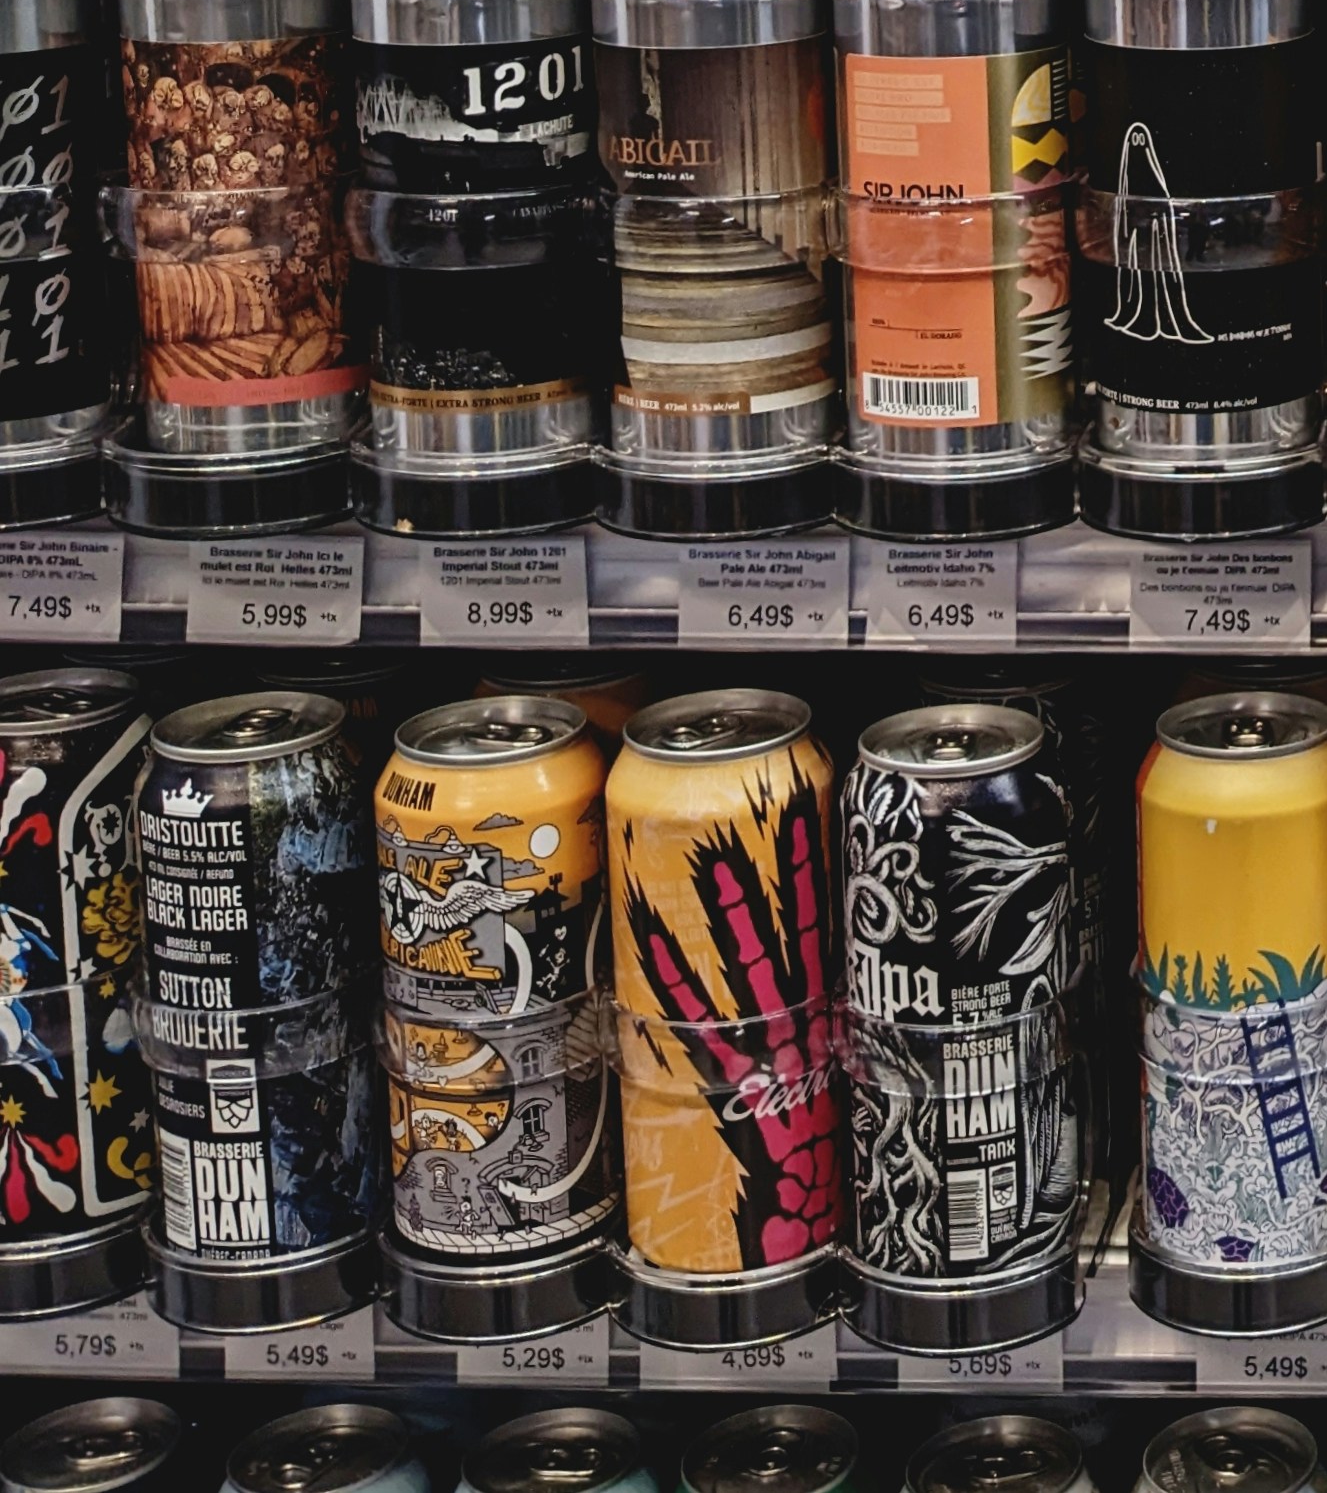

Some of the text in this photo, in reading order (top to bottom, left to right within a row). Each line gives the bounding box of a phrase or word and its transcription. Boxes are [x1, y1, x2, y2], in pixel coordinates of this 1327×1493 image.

[463, 45, 584, 116] 1201
[530, 114, 574, 137] LACHUTE
[657, 172, 695, 181] Pale Ale
[8, 596, 72, 620] 7,49$
[242, 603, 307, 628] 5,99$
[467, 602, 533, 626] 8,99$
[727, 604, 794, 628] 6,49$
[1185, 610, 1251, 633] 7,49$
[382, 772, 435, 812] DUNHAM
[207, 850, 247, 863] ALC/VOL
[146, 875, 242, 907] LAGER NOIRE
[147, 899, 248, 931] BLACK LAGER
[159, 970, 232, 1009] SUTTON
[943, 1034, 1014, 1059] BRASSERIE
[947, 1090, 1016, 1138] HAM
[193, 1140, 264, 1158] BRASSERIE
[194, 1158, 266, 1201] DUN
[199, 1200, 270, 1241] HAM
[267, 1344, 329, 1368] 5,49$
[1244, 1356, 1308, 1380] 5,49$
